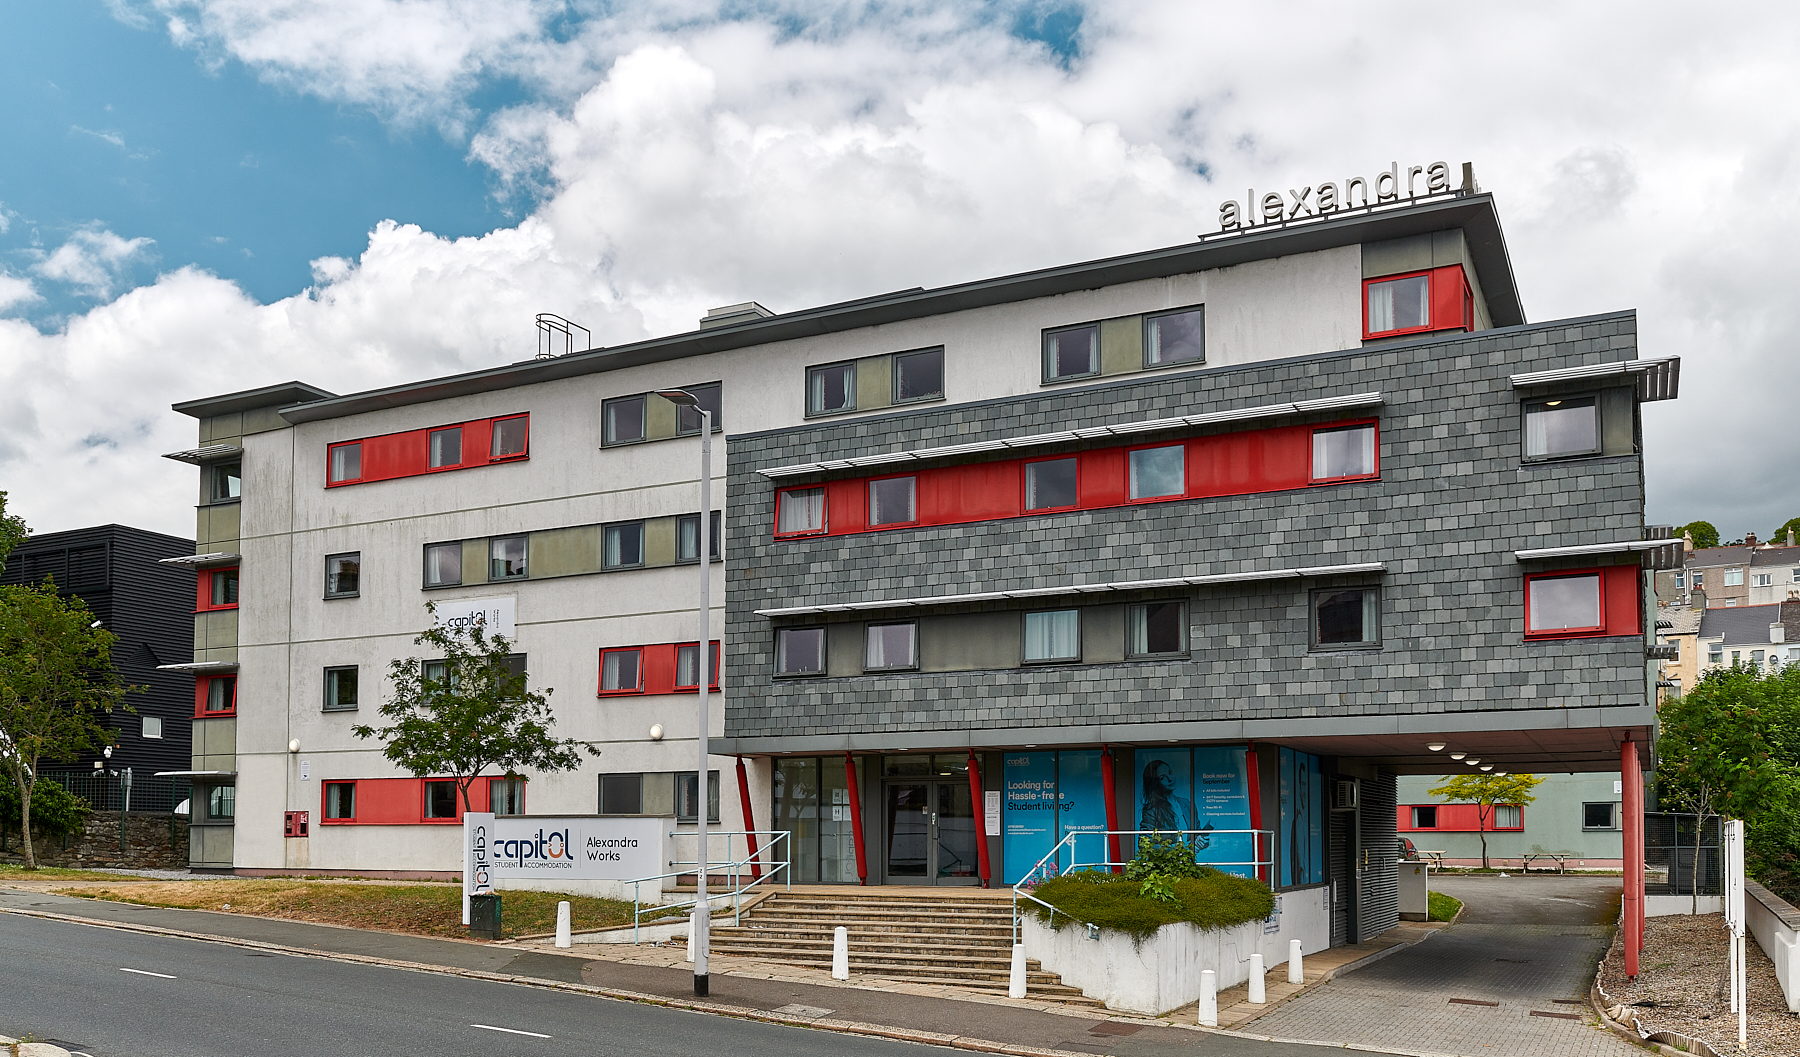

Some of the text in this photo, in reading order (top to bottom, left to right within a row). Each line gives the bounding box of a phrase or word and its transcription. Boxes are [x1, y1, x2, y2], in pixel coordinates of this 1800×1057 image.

[1219, 161, 1450, 226] alexandra
[1008, 780, 1055, 791] Looking for
[1008, 802, 1040, 811] Student
[587, 837, 638, 848] Alexandra
[494, 829, 573, 868] capitol
[473, 826, 490, 891] capitol
[587, 850, 620, 861] Works
